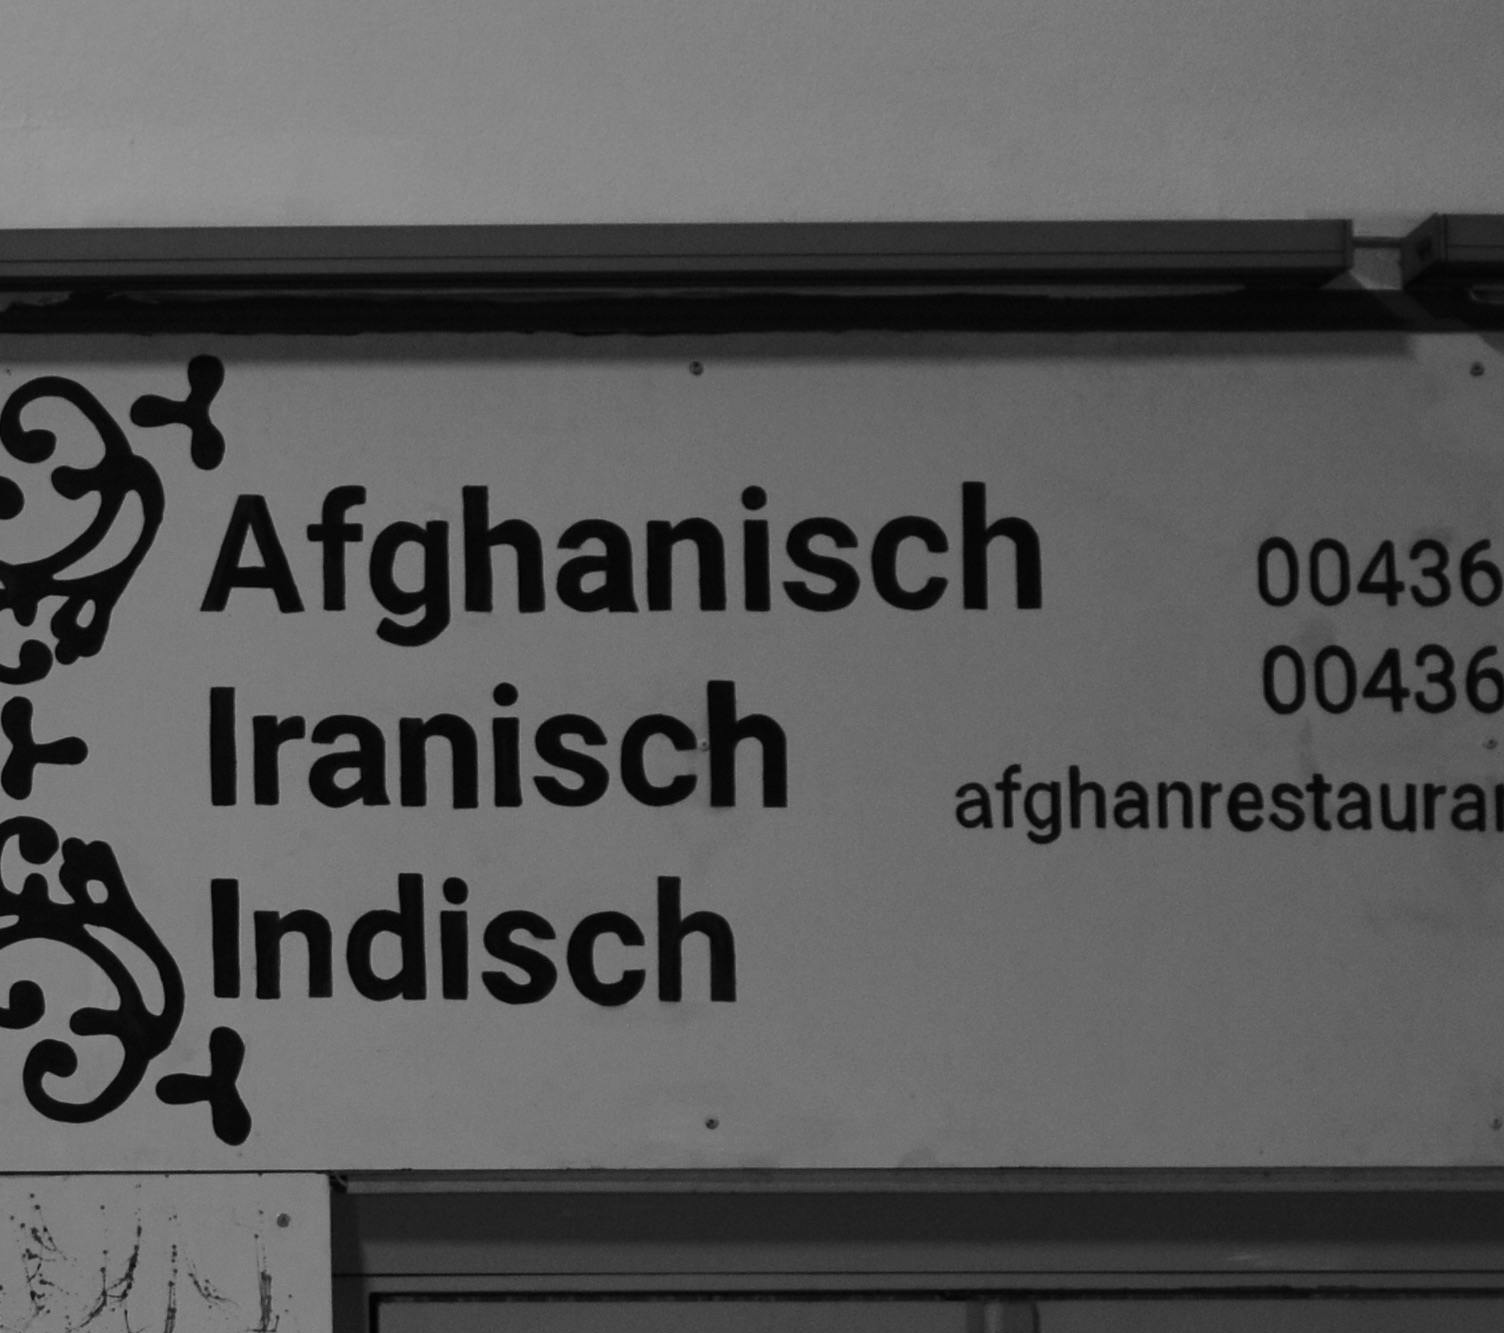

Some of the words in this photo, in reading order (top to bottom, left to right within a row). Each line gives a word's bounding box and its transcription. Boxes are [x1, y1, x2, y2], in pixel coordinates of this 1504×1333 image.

[198, 479, 1044, 649] Afghanisch
[1256, 536, 1504, 608] 00436
[208, 678, 789, 810] Iranisch
[1262, 643, 1504, 716] 00436
[209, 871, 738, 1008] Indisch
